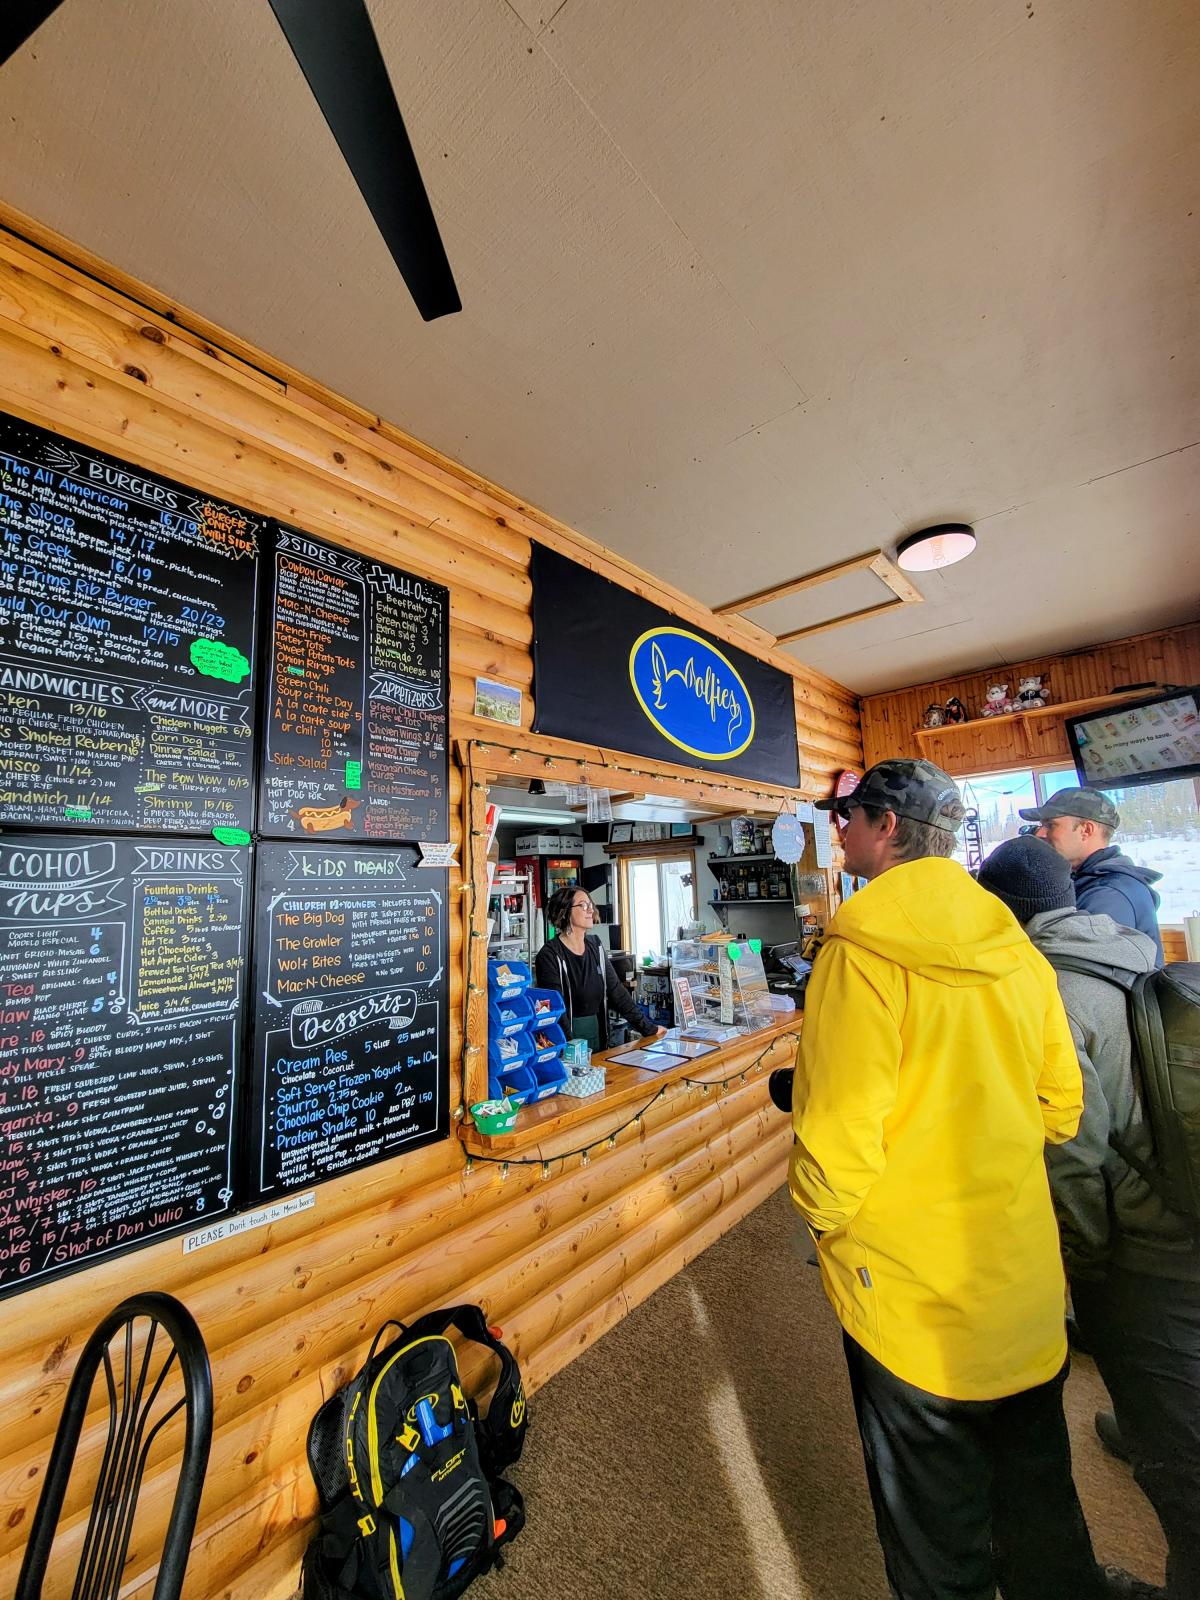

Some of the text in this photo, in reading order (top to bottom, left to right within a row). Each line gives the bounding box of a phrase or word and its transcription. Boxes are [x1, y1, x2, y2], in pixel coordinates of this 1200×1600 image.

[0, 456, 129, 511] The All American
[89, 462, 178, 508] BURGERS
[28, 503, 75, 530] Sloop
[204, 507, 247, 529] BURGER
[28, 535, 77, 561] Greek
[228, 535, 252, 551] SIDE
[291, 537, 338, 566] SIDES
[23, 564, 71, 588] Prime
[76, 578, 101, 596] Rib
[105, 587, 157, 611] Burger
[30, 599, 73, 619] Your
[20, 621, 140, 655] Cheese Bacon
[276, 674, 307, 688] Green
[276, 685, 302, 700] Soup
[180, 698, 230, 720] MORE
[150, 715, 192, 729] Chicken
[193, 721, 228, 735] Nuggets
[18, 726, 128, 752] Smoked Reuben
[151, 733, 203, 749] Corn Dog
[273, 752, 327, 770] Side Salad
[145, 769, 168, 782] The
[143, 796, 193, 809] Shrimp
[150, 851, 225, 871] DRINKS
[276, 911, 345, 927] The Big Dog
[144, 925, 176, 936] Coffee
[276, 938, 301, 951] The
[277, 955, 342, 971] Wolf Bites
[299, 993, 411, 1041] Desserts
[24, 1055, 66, 1072] Mary
[276, 1049, 348, 1075] Cream Pies
[276, 1062, 402, 1103] Soft Serve Frozen Yogurt
[276, 1098, 319, 1117] Churro
[276, 1091, 385, 1132] Chocolate Chip Cookie
[276, 1129, 319, 1150] Protein
[321, 1116, 358, 1137] Shake
[188, 1225, 224, 1250] PLEASE
[54, 1237, 94, 1262] Shot
